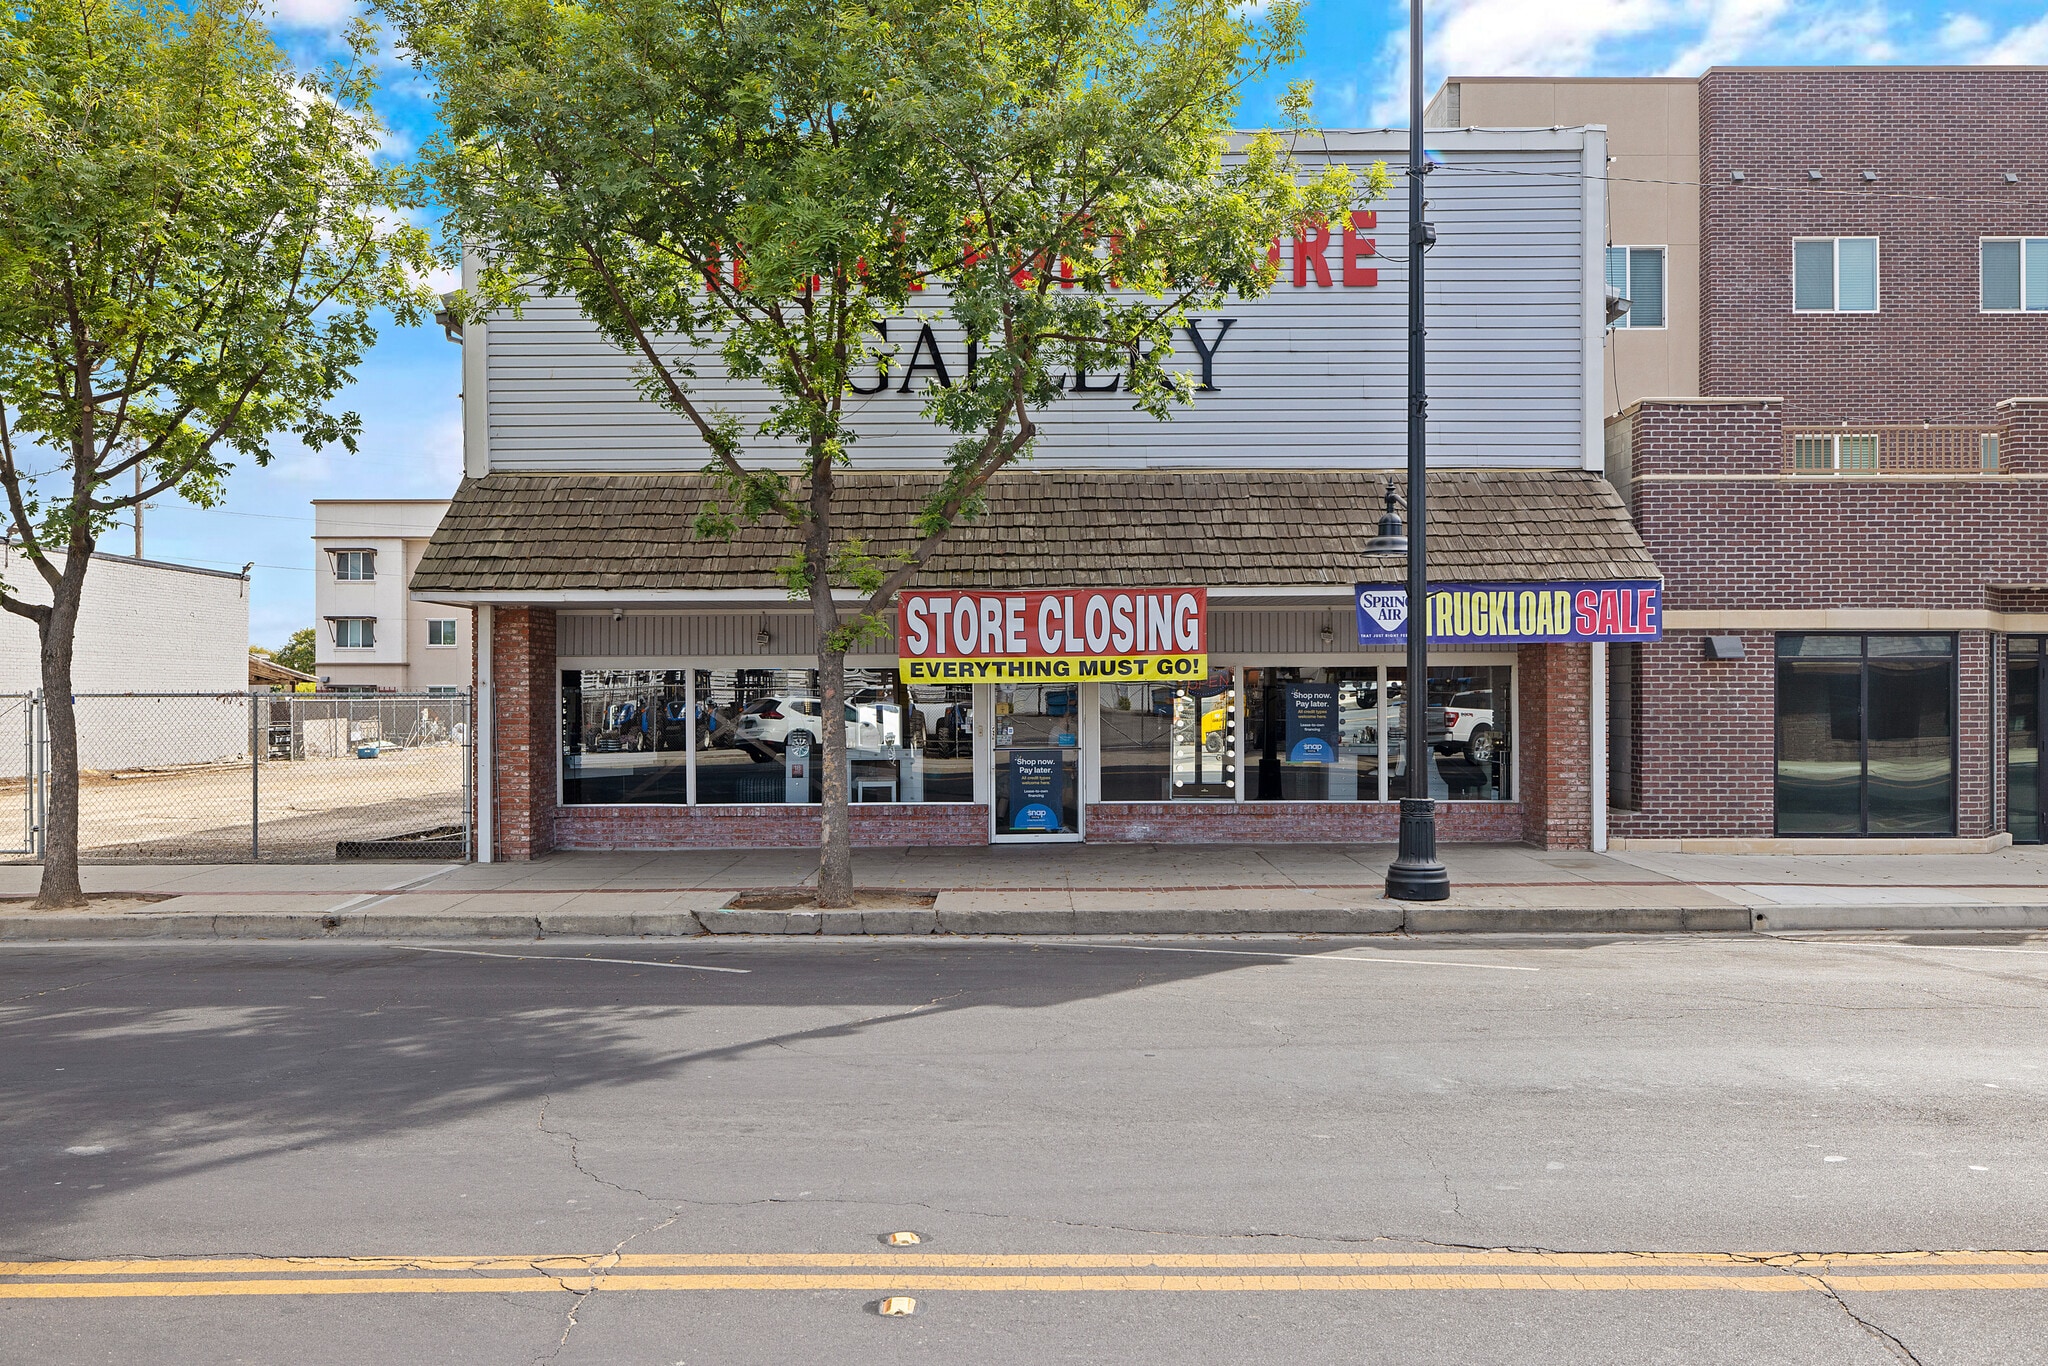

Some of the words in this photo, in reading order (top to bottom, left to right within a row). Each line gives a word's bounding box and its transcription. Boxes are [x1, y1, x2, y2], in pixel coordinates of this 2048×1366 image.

[1363, 593, 1408, 608] SPRIN
[1378, 608, 1401, 620] AIR
[1425, 591, 1570, 636] TRUCKLOAD
[1575, 589, 1657, 635] SALE
[906, 596, 1027, 655] STORE
[1038, 593, 1199, 653] CLOSING
[910, 661, 1070, 678] EVERYTHING
[1079, 659, 1148, 676] MUST
[1157, 658, 1199, 674] GO!
[1293, 692, 1312, 700] Shop
[1296, 700, 1310, 708] Pay
